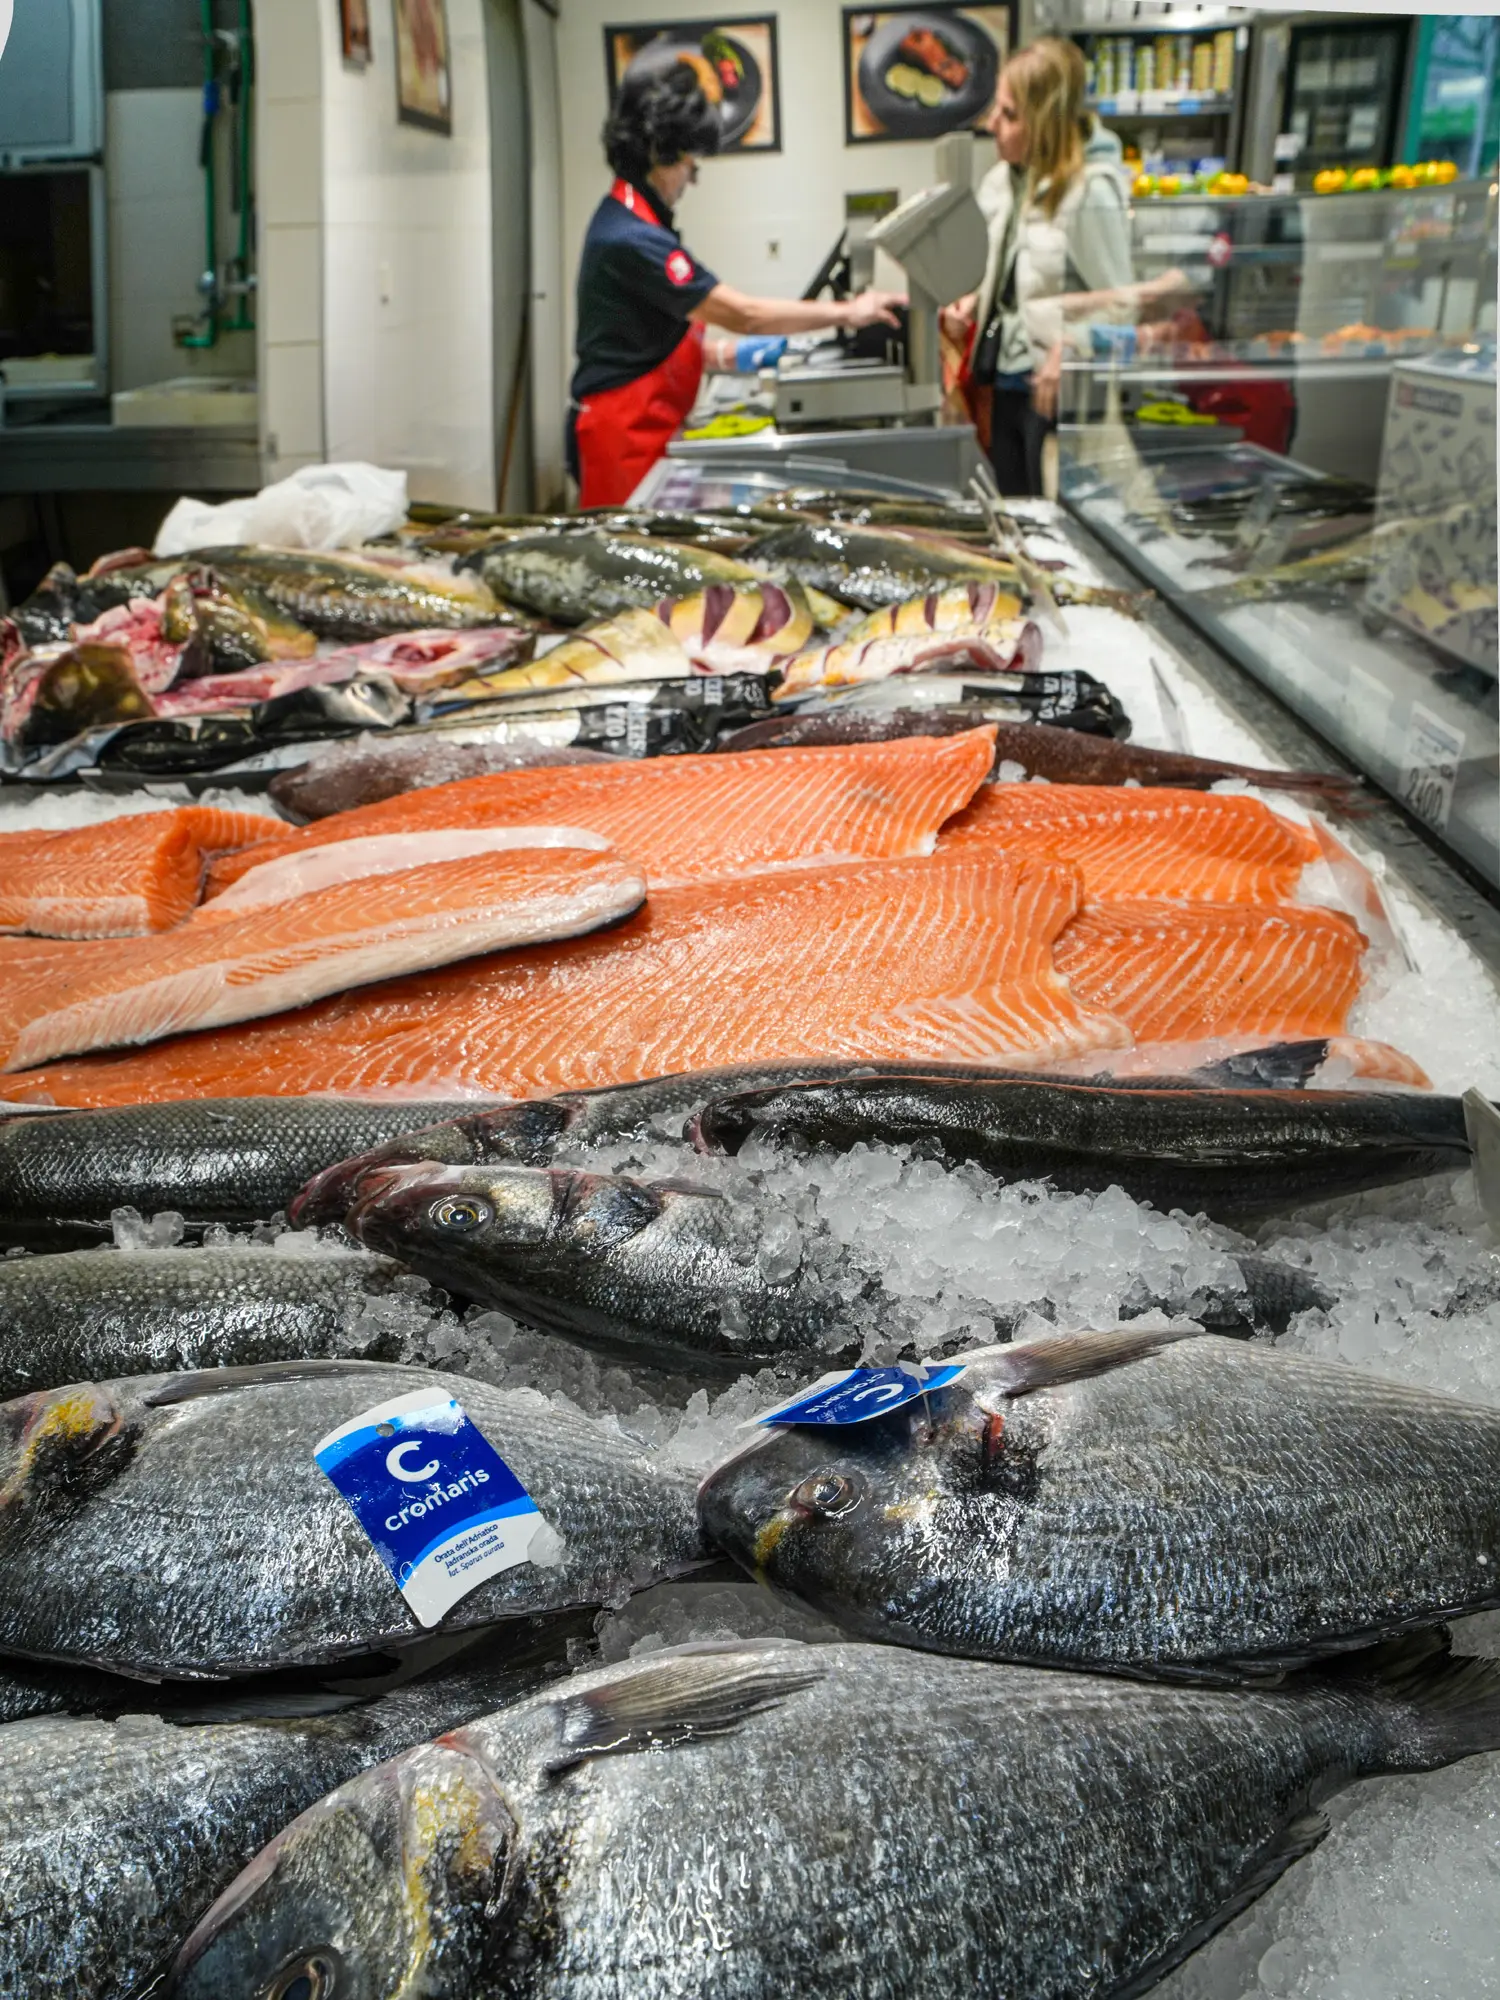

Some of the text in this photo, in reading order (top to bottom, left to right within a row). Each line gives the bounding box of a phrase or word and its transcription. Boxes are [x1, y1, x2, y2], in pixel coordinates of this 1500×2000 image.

[805, 1373, 885, 1414] cromaris
[385, 1469, 490, 1531] cromaris
[434, 1523, 499, 1564] Orata dell'Adriatico
[445, 1534, 499, 1569] Jadranska orada
[460, 1553, 484, 1571] Sparus
[483, 1541, 505, 1557] aurata
